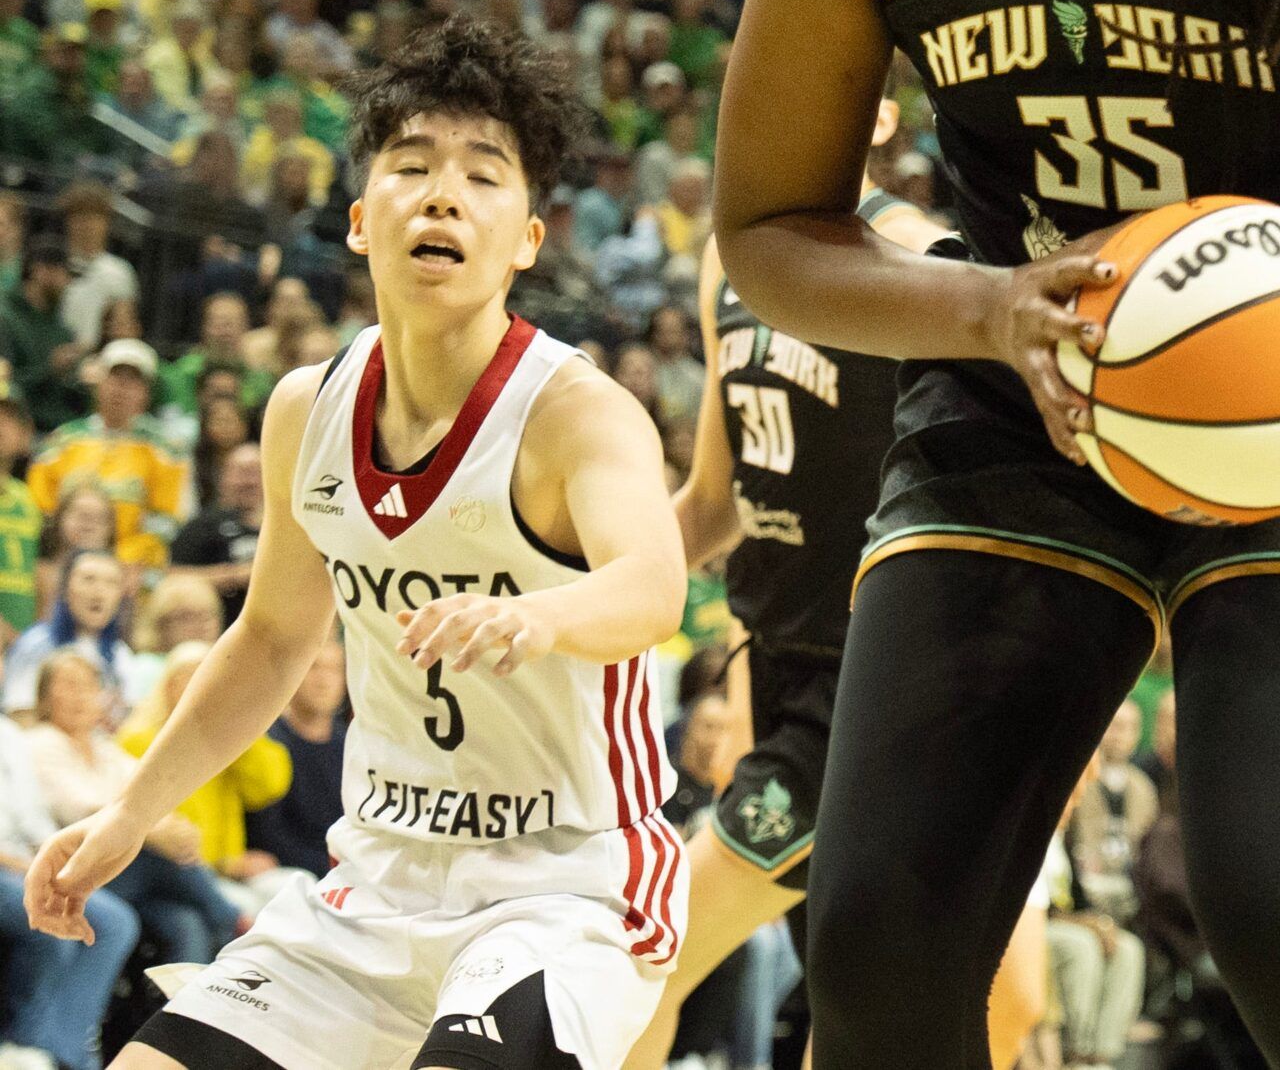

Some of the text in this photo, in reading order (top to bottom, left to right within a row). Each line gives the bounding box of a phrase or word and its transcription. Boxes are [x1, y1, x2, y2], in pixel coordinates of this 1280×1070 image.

[920, 4, 1048, 88] NEW
[1016, 95, 1189, 212] 35
[727, 382, 795, 476] 30
[303, 501, 345, 517] ANTELOPES
[320, 552, 523, 612] OYOTA
[206, 984, 271, 1012] ANTELOPES
